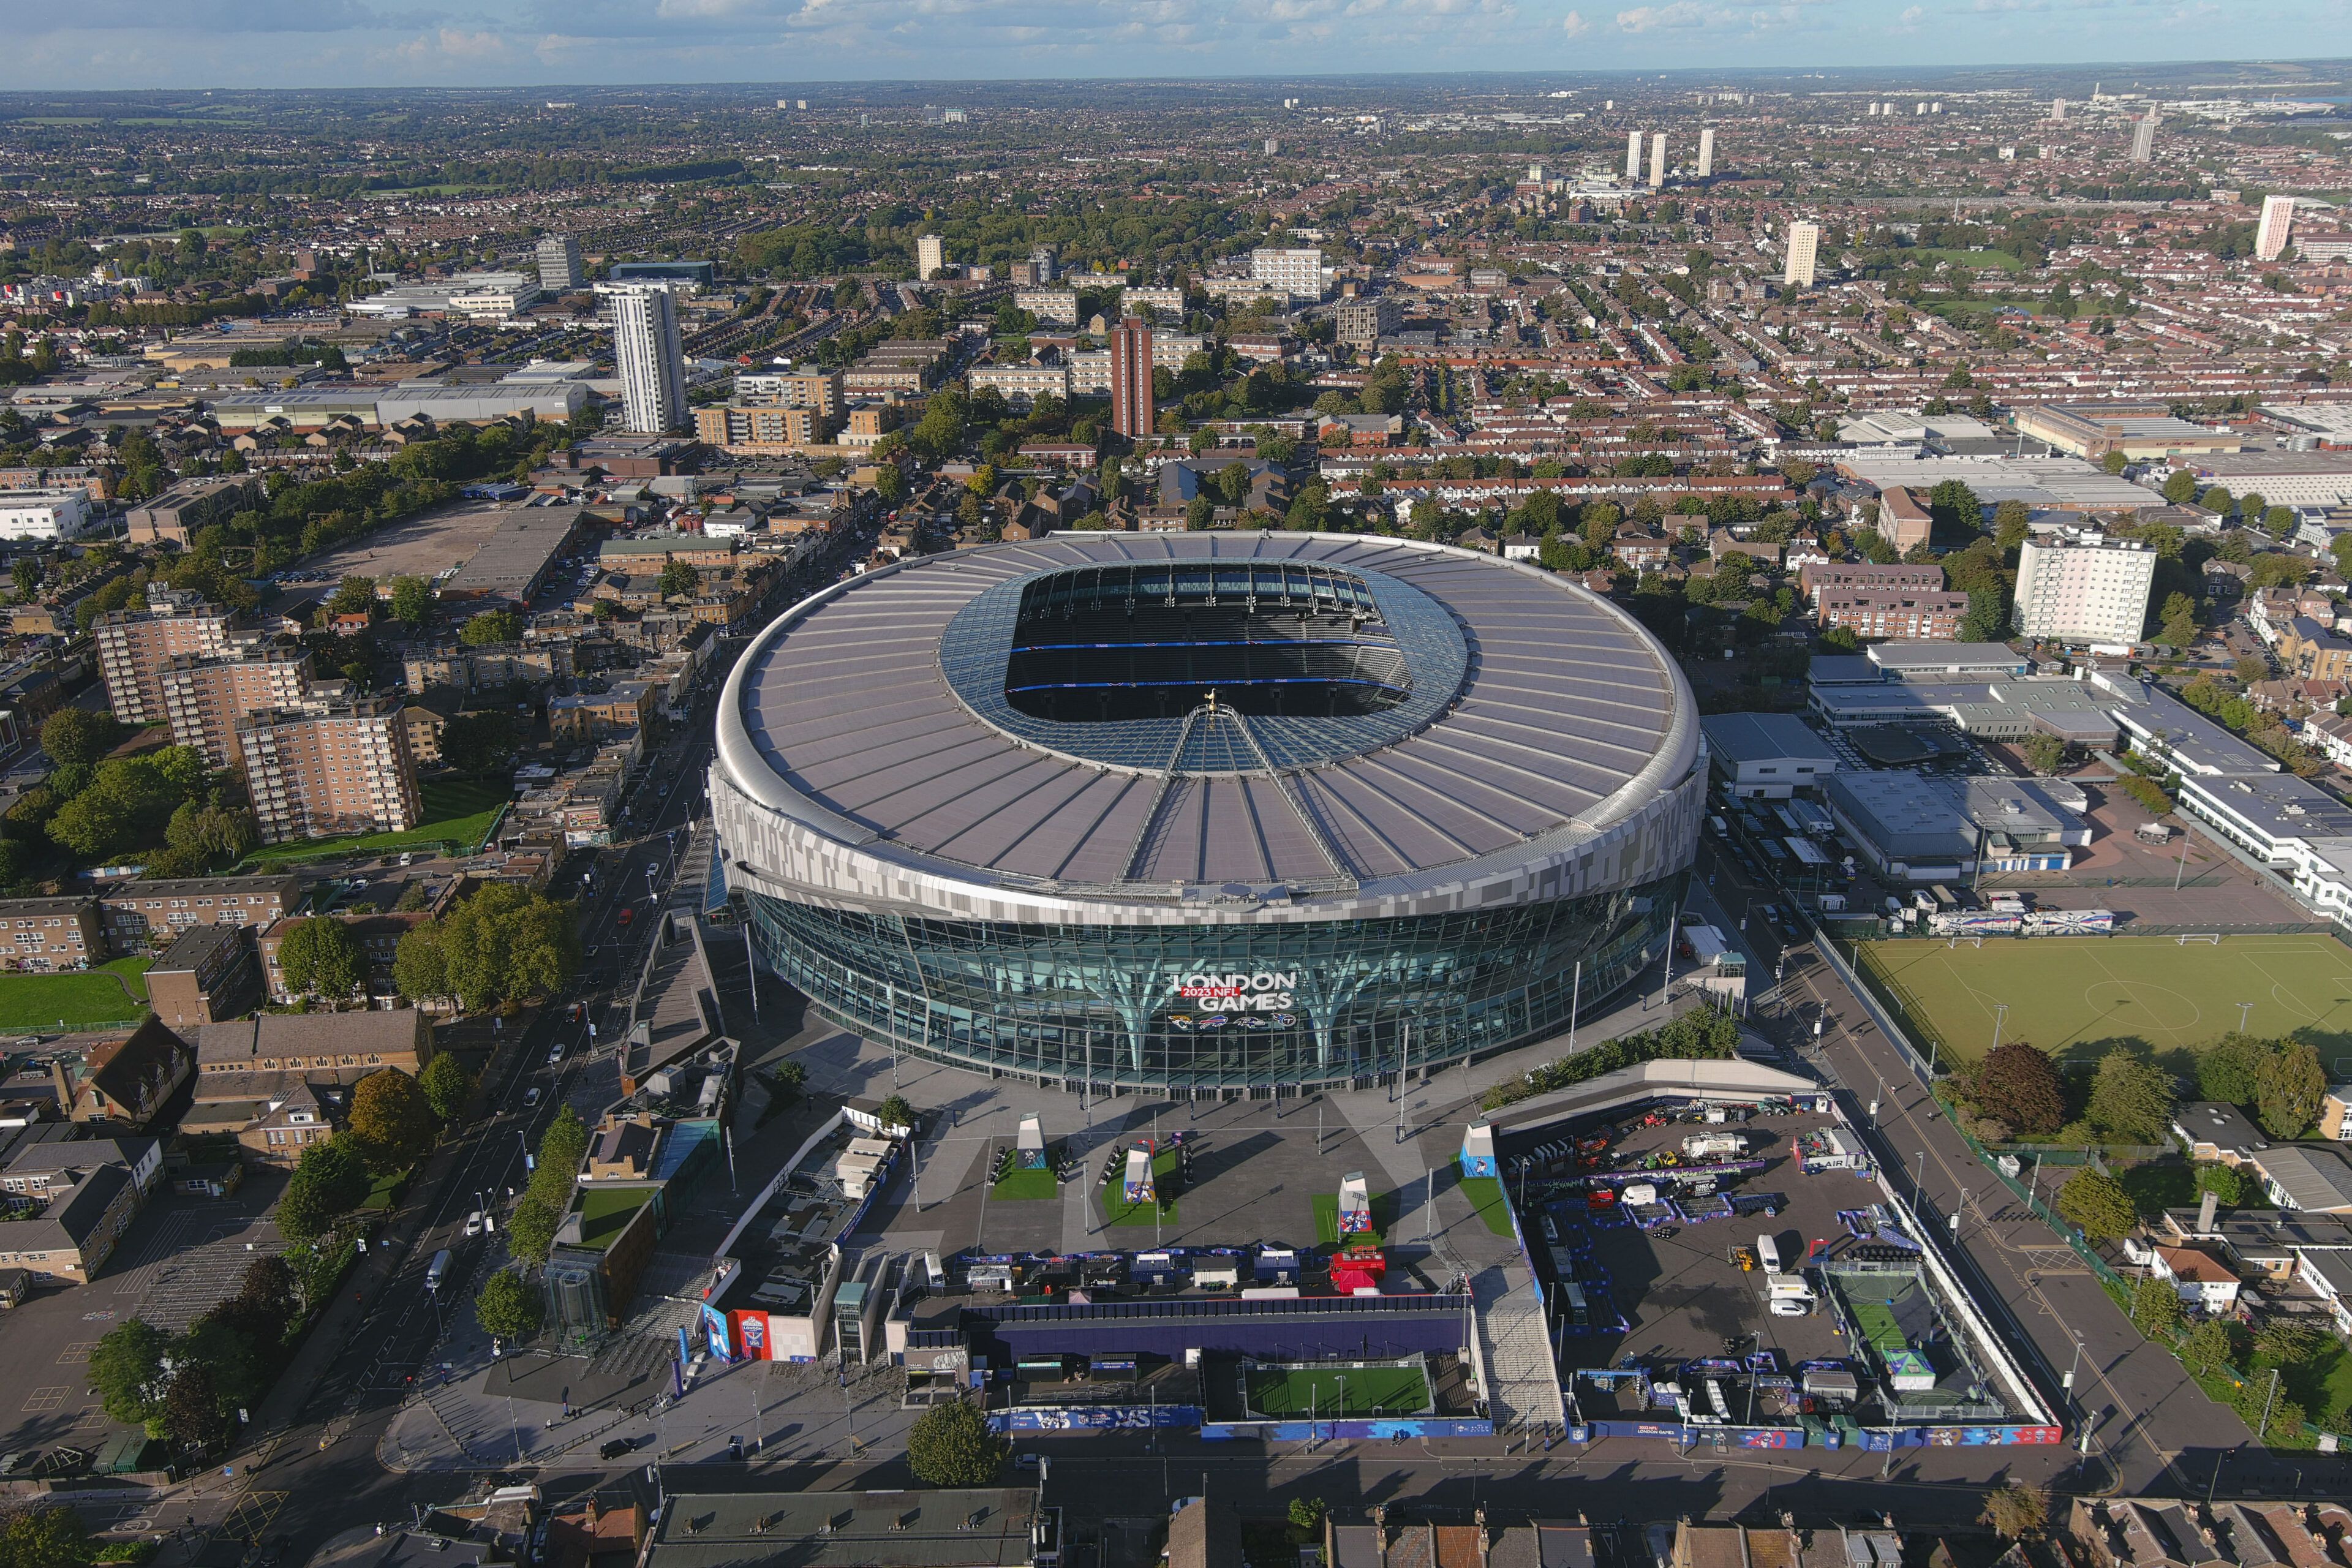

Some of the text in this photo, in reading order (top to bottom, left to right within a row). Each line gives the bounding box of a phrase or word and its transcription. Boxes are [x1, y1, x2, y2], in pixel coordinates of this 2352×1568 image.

[1173, 971, 1296, 992] LONDON
[1183, 988, 1238, 997] 2023 NFL
[1198, 992, 1292, 1011] GAMES
